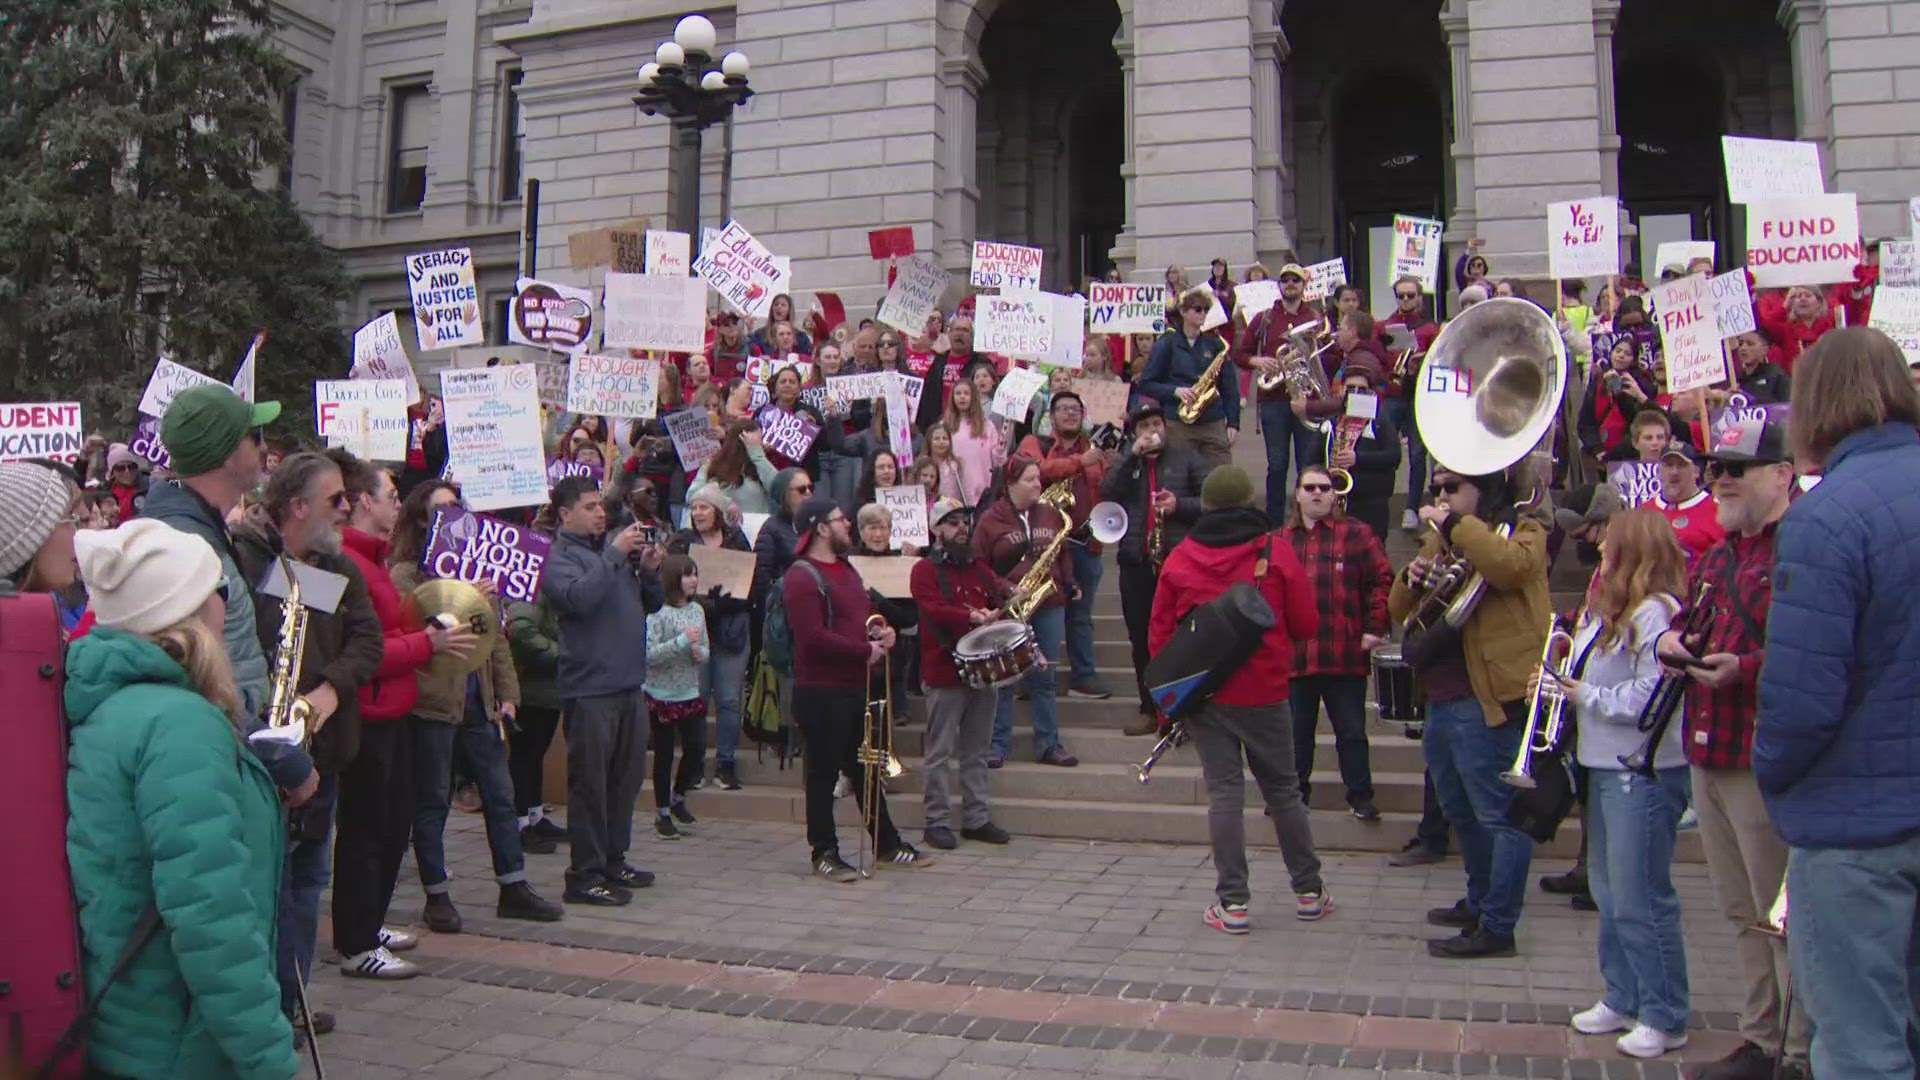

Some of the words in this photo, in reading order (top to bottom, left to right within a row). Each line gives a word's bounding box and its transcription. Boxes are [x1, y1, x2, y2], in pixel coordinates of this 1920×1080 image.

[1570, 204, 1594, 227] Yes
[1395, 219, 1440, 240] WTF?
[1563, 231, 1579, 246] to
[1584, 225, 1604, 244] Ed!
[1763, 217, 1835, 239] FUND
[659, 253, 681, 266] More
[720, 224, 781, 281] Education
[975, 243, 1040, 266] EDUCATION
[1748, 242, 1859, 266] EDUCATION
[410, 251, 469, 282] LITERACY
[714, 250, 753, 281] CUTS
[980, 261, 1031, 276] MATTERS
[430, 273, 459, 289] AND
[973, 272, 1002, 287] FUND
[1711, 271, 1745, 299] OKS
[416, 286, 475, 306] JUSTICE
[1136, 286, 1164, 302] CUT
[436, 307, 462, 322] FOR
[1093, 305, 1114, 324] MY
[1118, 303, 1164, 320] FUTURE
[1664, 304, 1704, 333] FAIL
[437, 325, 463, 341] ALL
[983, 333, 1048, 352] LEADERS
[368, 356, 386, 375] NO
[578, 357, 650, 376] ENOUGH!
[0, 405, 79, 428] UDENT
[780, 412, 802, 429] NO
[1738, 407, 1766, 423] NO
[769, 419, 812, 445] MORE
[566, 463, 591, 477] NO
[884, 490, 921, 505] Fund
[1629, 479, 1662, 496] MO
[892, 508, 917, 519] our
[479, 519, 520, 548] NO
[892, 525, 928, 537] chools
[462, 536, 544, 576] MORE
[434, 551, 541, 602] CUTS!
